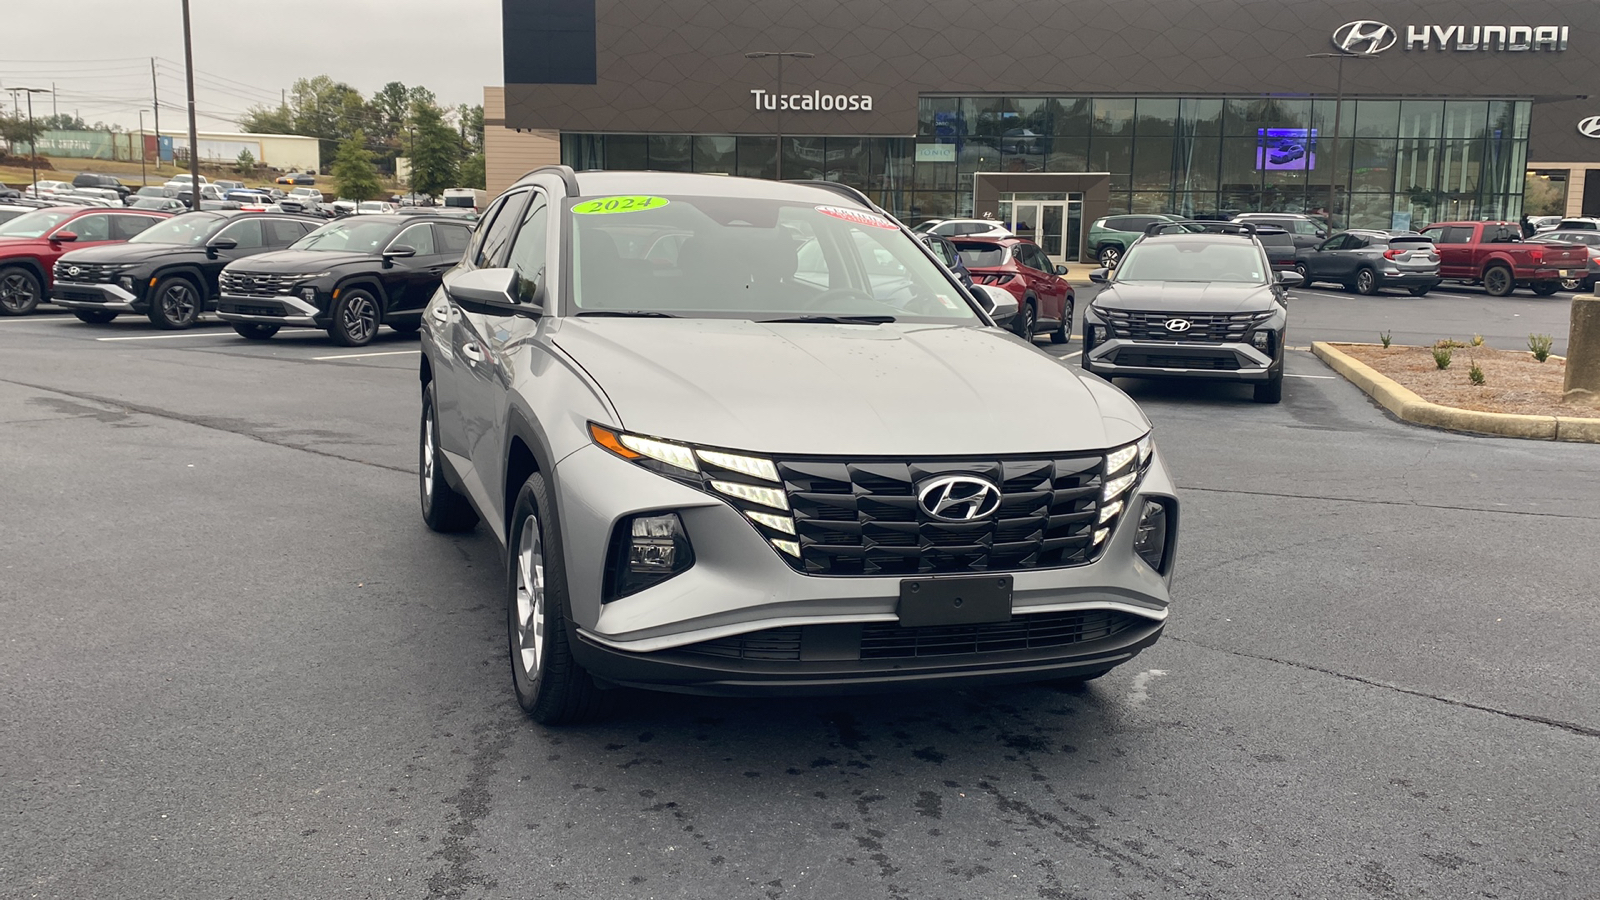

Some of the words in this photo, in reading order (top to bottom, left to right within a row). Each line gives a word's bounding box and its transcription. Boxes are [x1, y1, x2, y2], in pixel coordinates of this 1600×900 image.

[1406, 25, 1569, 51] HYUNDAI
[750, 89, 873, 111] Tuscaloosa
[58, 139, 91, 150] SHIPPING
[588, 197, 653, 213] 2024
